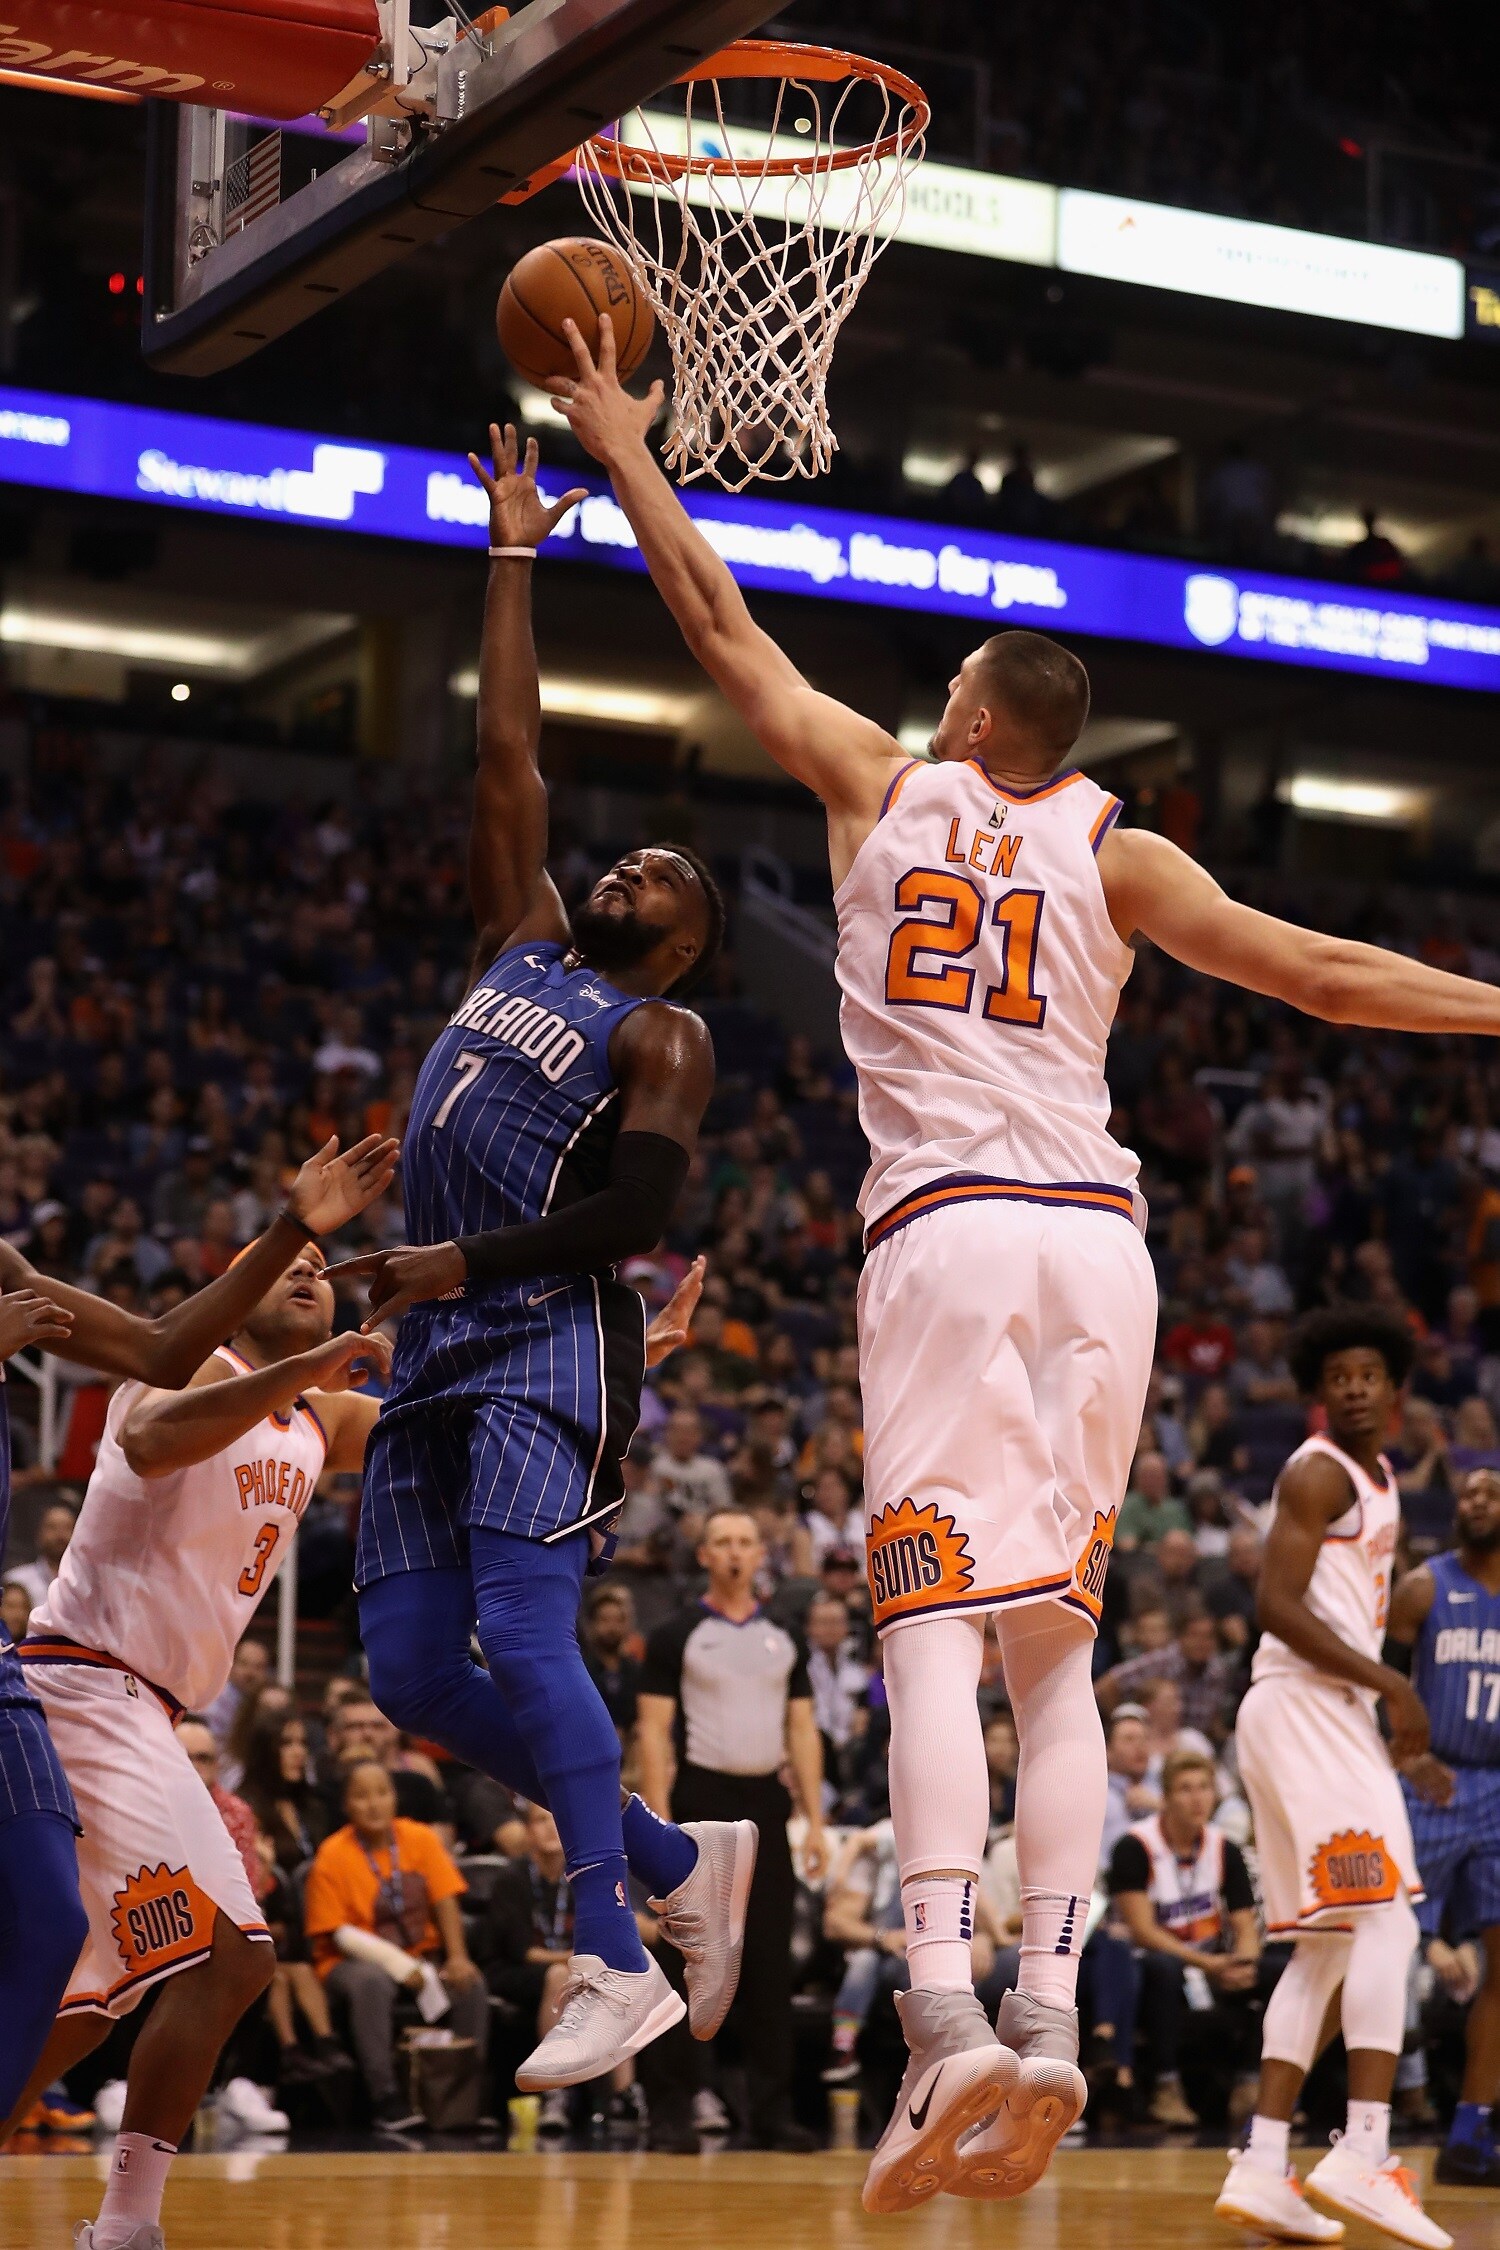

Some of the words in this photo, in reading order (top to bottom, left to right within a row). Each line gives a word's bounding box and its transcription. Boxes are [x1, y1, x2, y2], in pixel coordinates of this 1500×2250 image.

[944, 817, 1024, 878] LEN
[884, 866, 1048, 1030] 21
[430, 1050, 488, 1130] 7
[237, 1522, 280, 1598] 3
[871, 1531, 942, 1606] SUNS
[1465, 1668, 1500, 1724] 17
[1327, 1850, 1384, 1890] SUNS
[126, 1888, 195, 1958] SUNS
